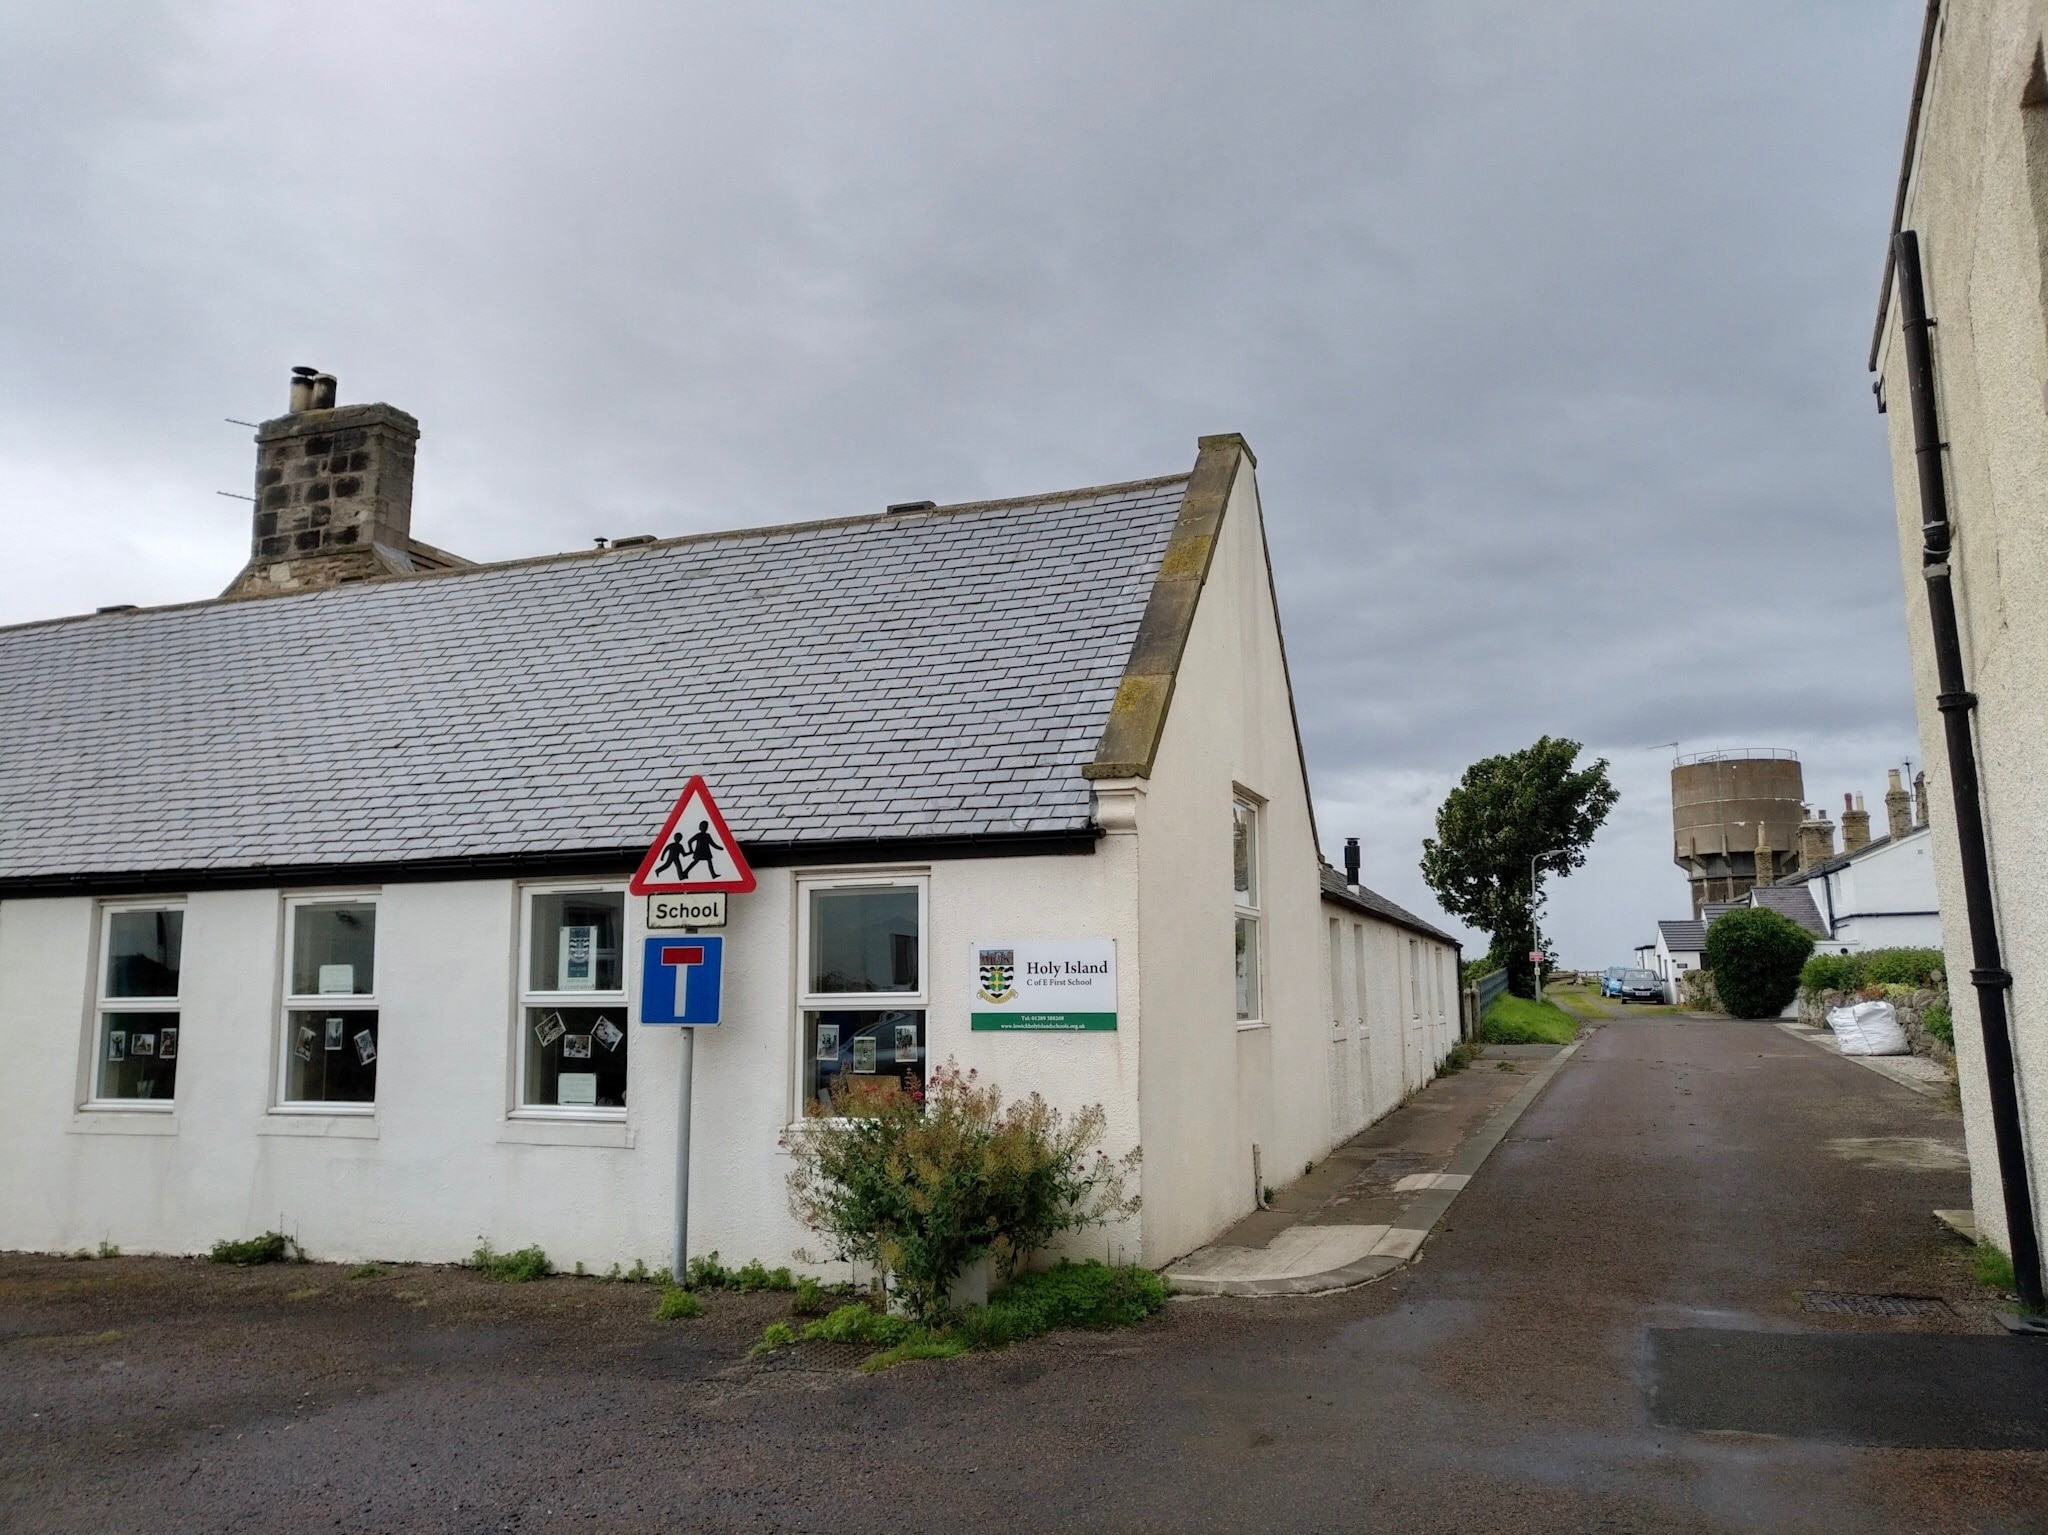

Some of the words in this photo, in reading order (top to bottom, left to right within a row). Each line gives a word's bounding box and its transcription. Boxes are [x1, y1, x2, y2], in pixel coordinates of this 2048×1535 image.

[656, 902, 719, 919] School
[1027, 961, 1061, 978] Holy
[1065, 960, 1108, 974] Island
[1034, 978, 1042, 986] of
[1049, 978, 1066, 986] First
[1067, 978, 1091, 986] School
